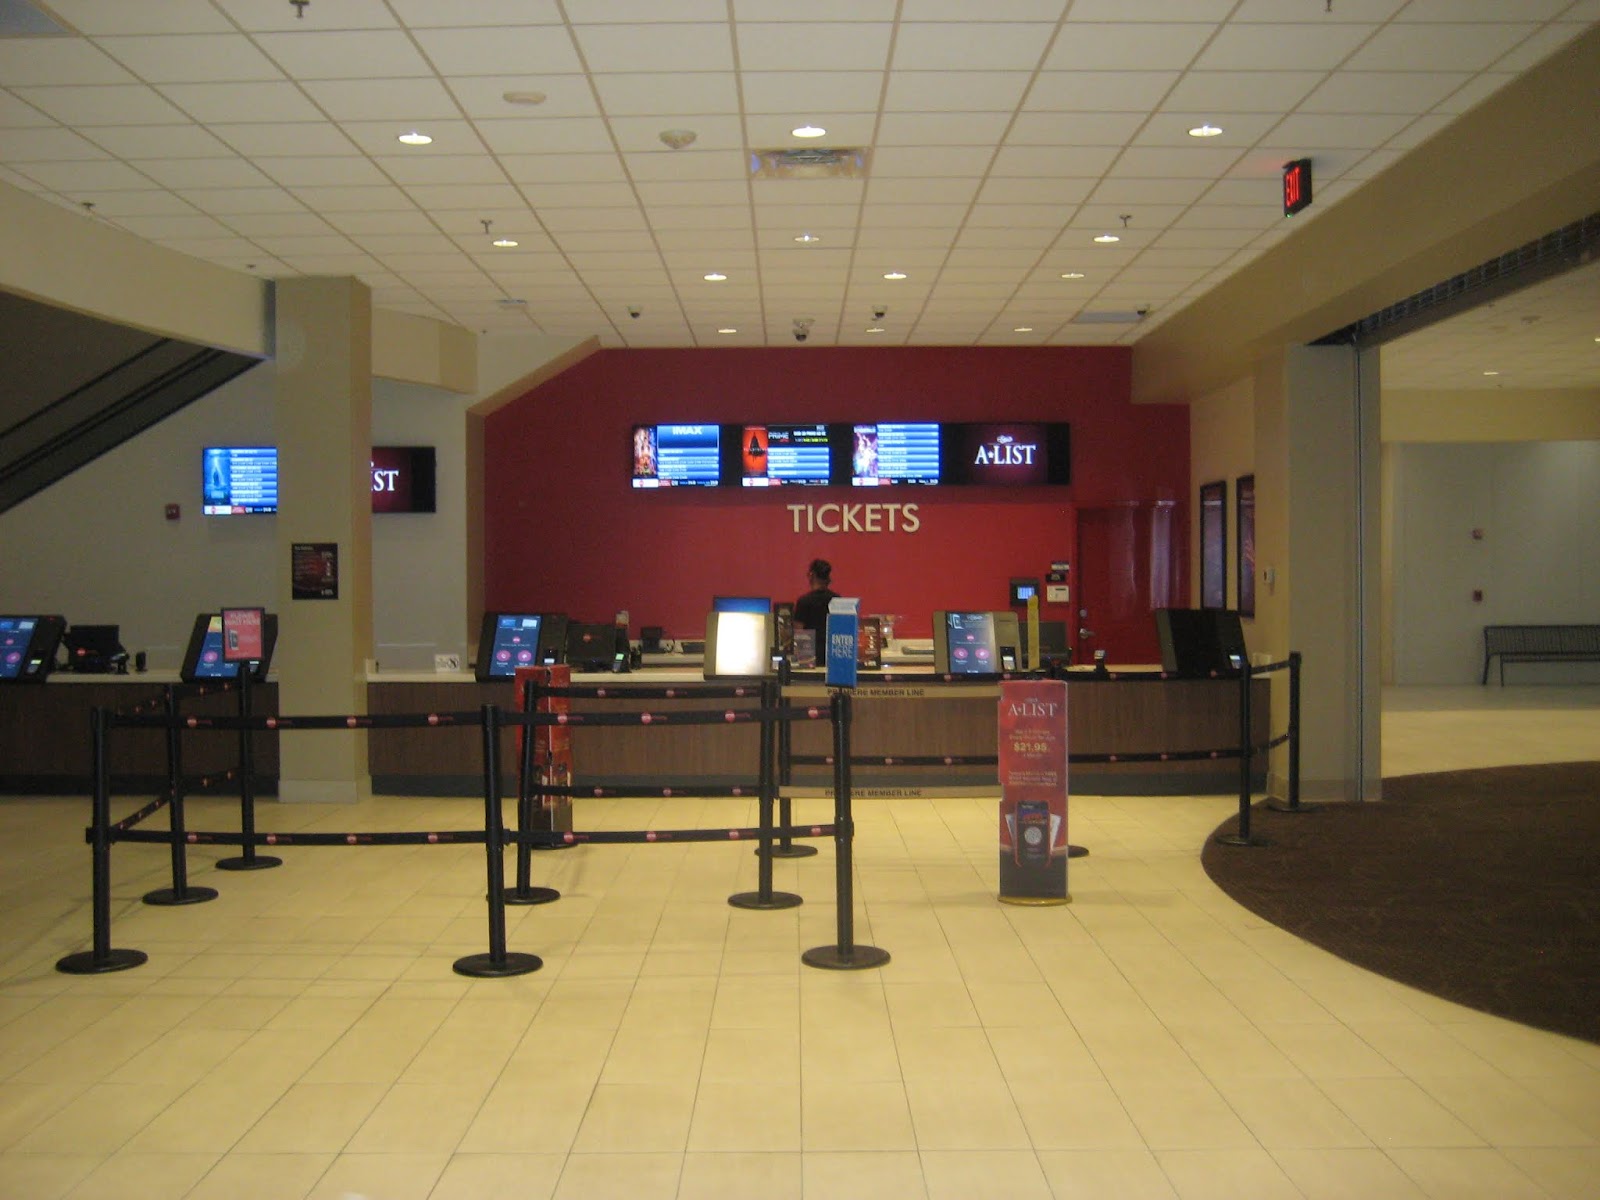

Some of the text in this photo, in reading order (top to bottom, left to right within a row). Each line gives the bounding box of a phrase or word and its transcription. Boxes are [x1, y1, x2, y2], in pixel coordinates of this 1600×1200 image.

[1286, 166, 1300, 207] EXIT
[672, 426, 703, 435] IMAX
[371, 470, 399, 491] ST
[787, 503, 920, 533] TICKETS
[832, 634, 853, 645] ENTER
[832, 645, 853, 659] HERE
[870, 689, 904, 697] MEMBER
